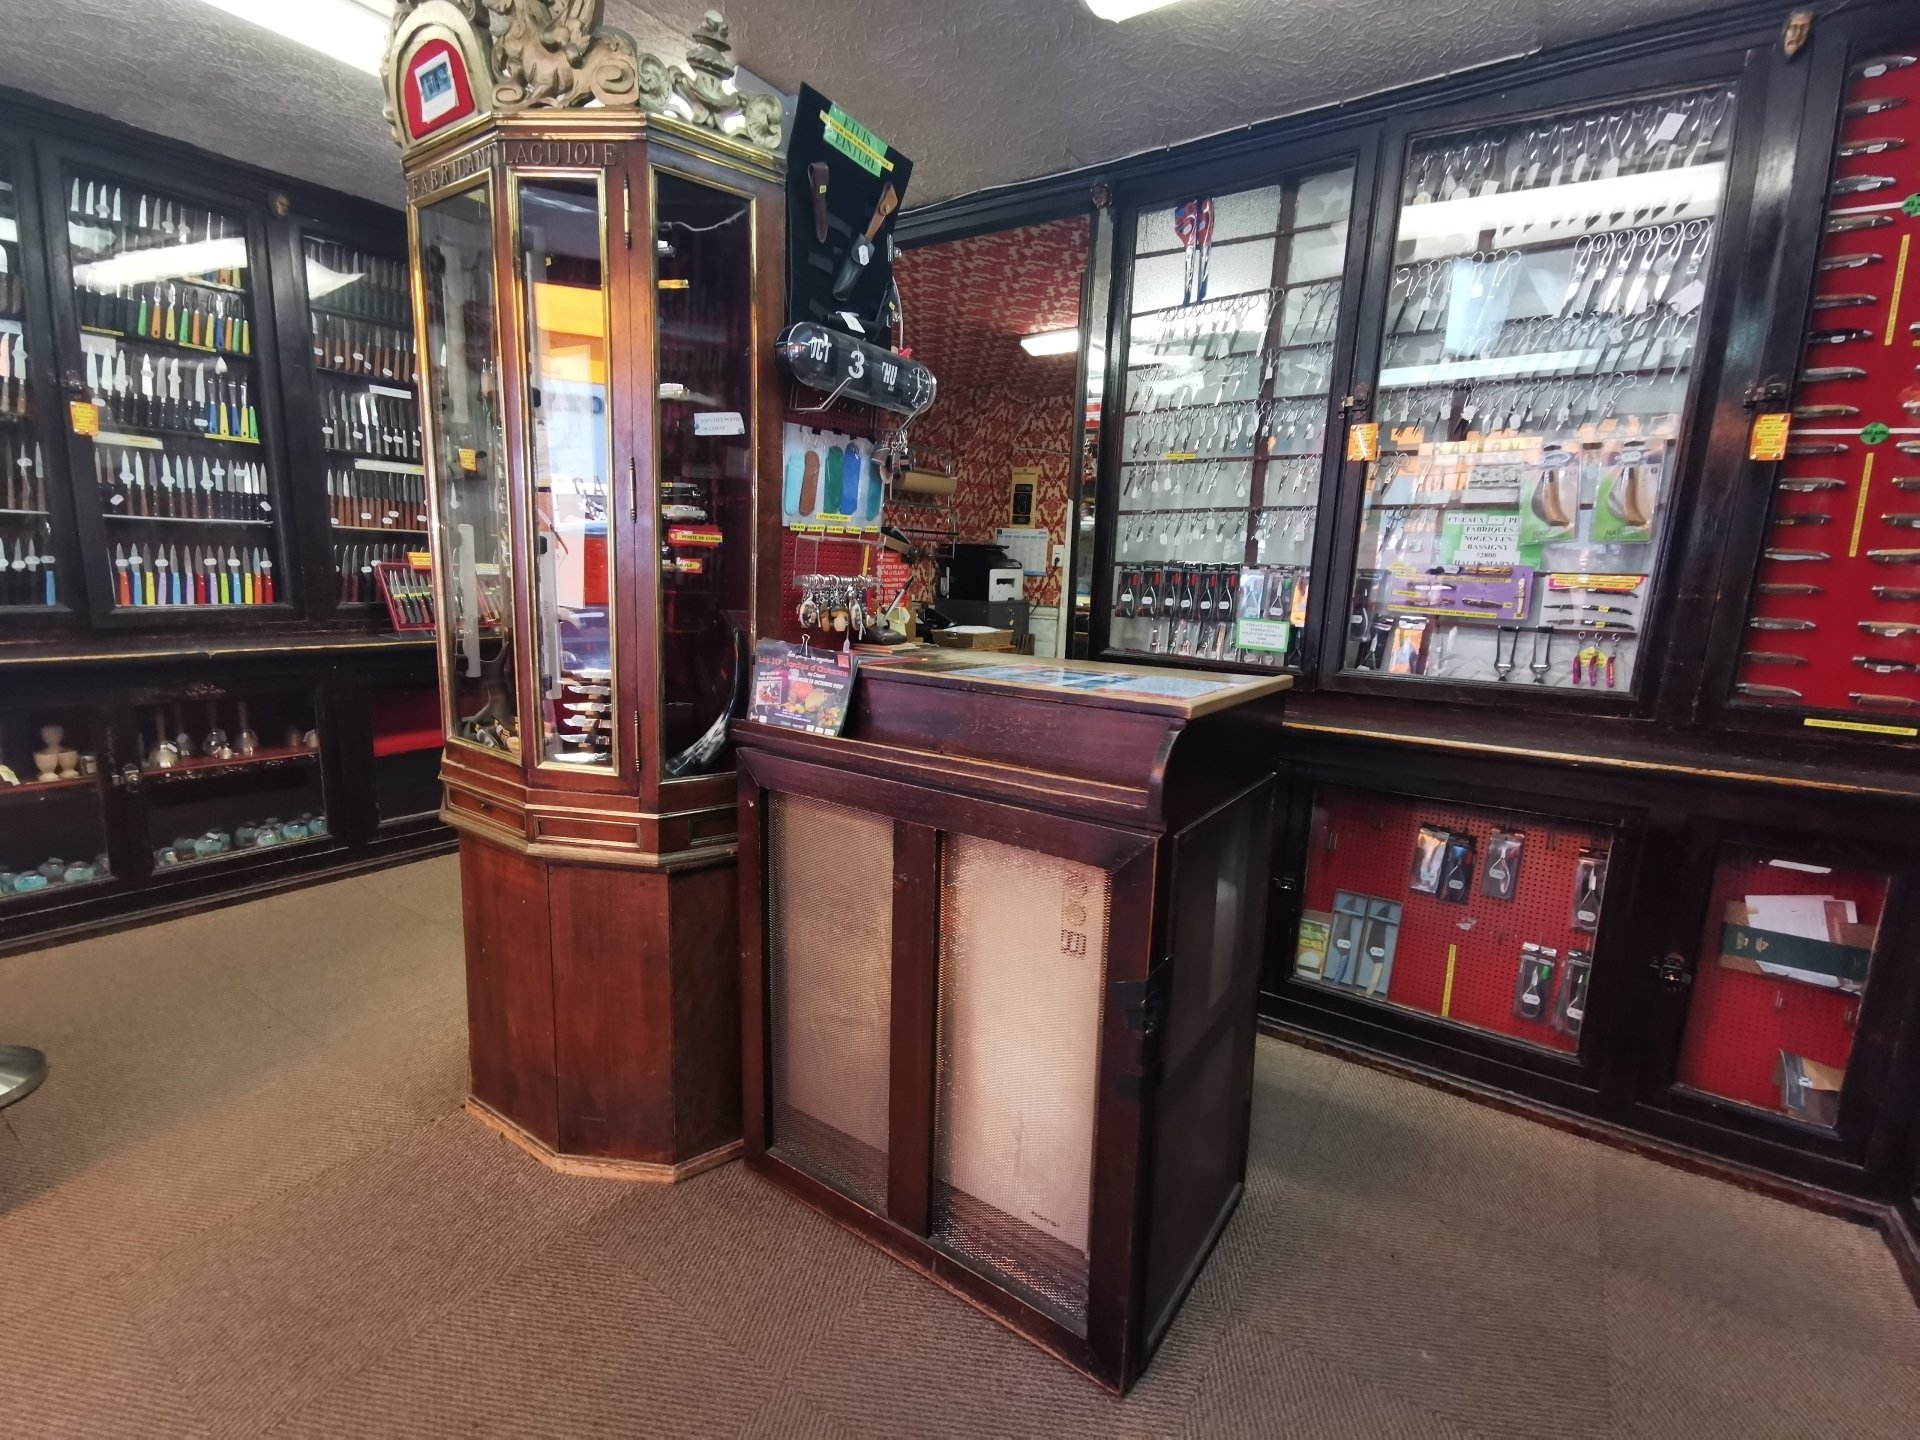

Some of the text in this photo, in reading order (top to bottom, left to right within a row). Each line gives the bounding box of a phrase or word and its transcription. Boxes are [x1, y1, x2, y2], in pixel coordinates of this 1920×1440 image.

[411, 141, 617, 199] FABRICANT LAGUIOLE
[848, 350, 865, 379] 3
[881, 361, 899, 386] THU
